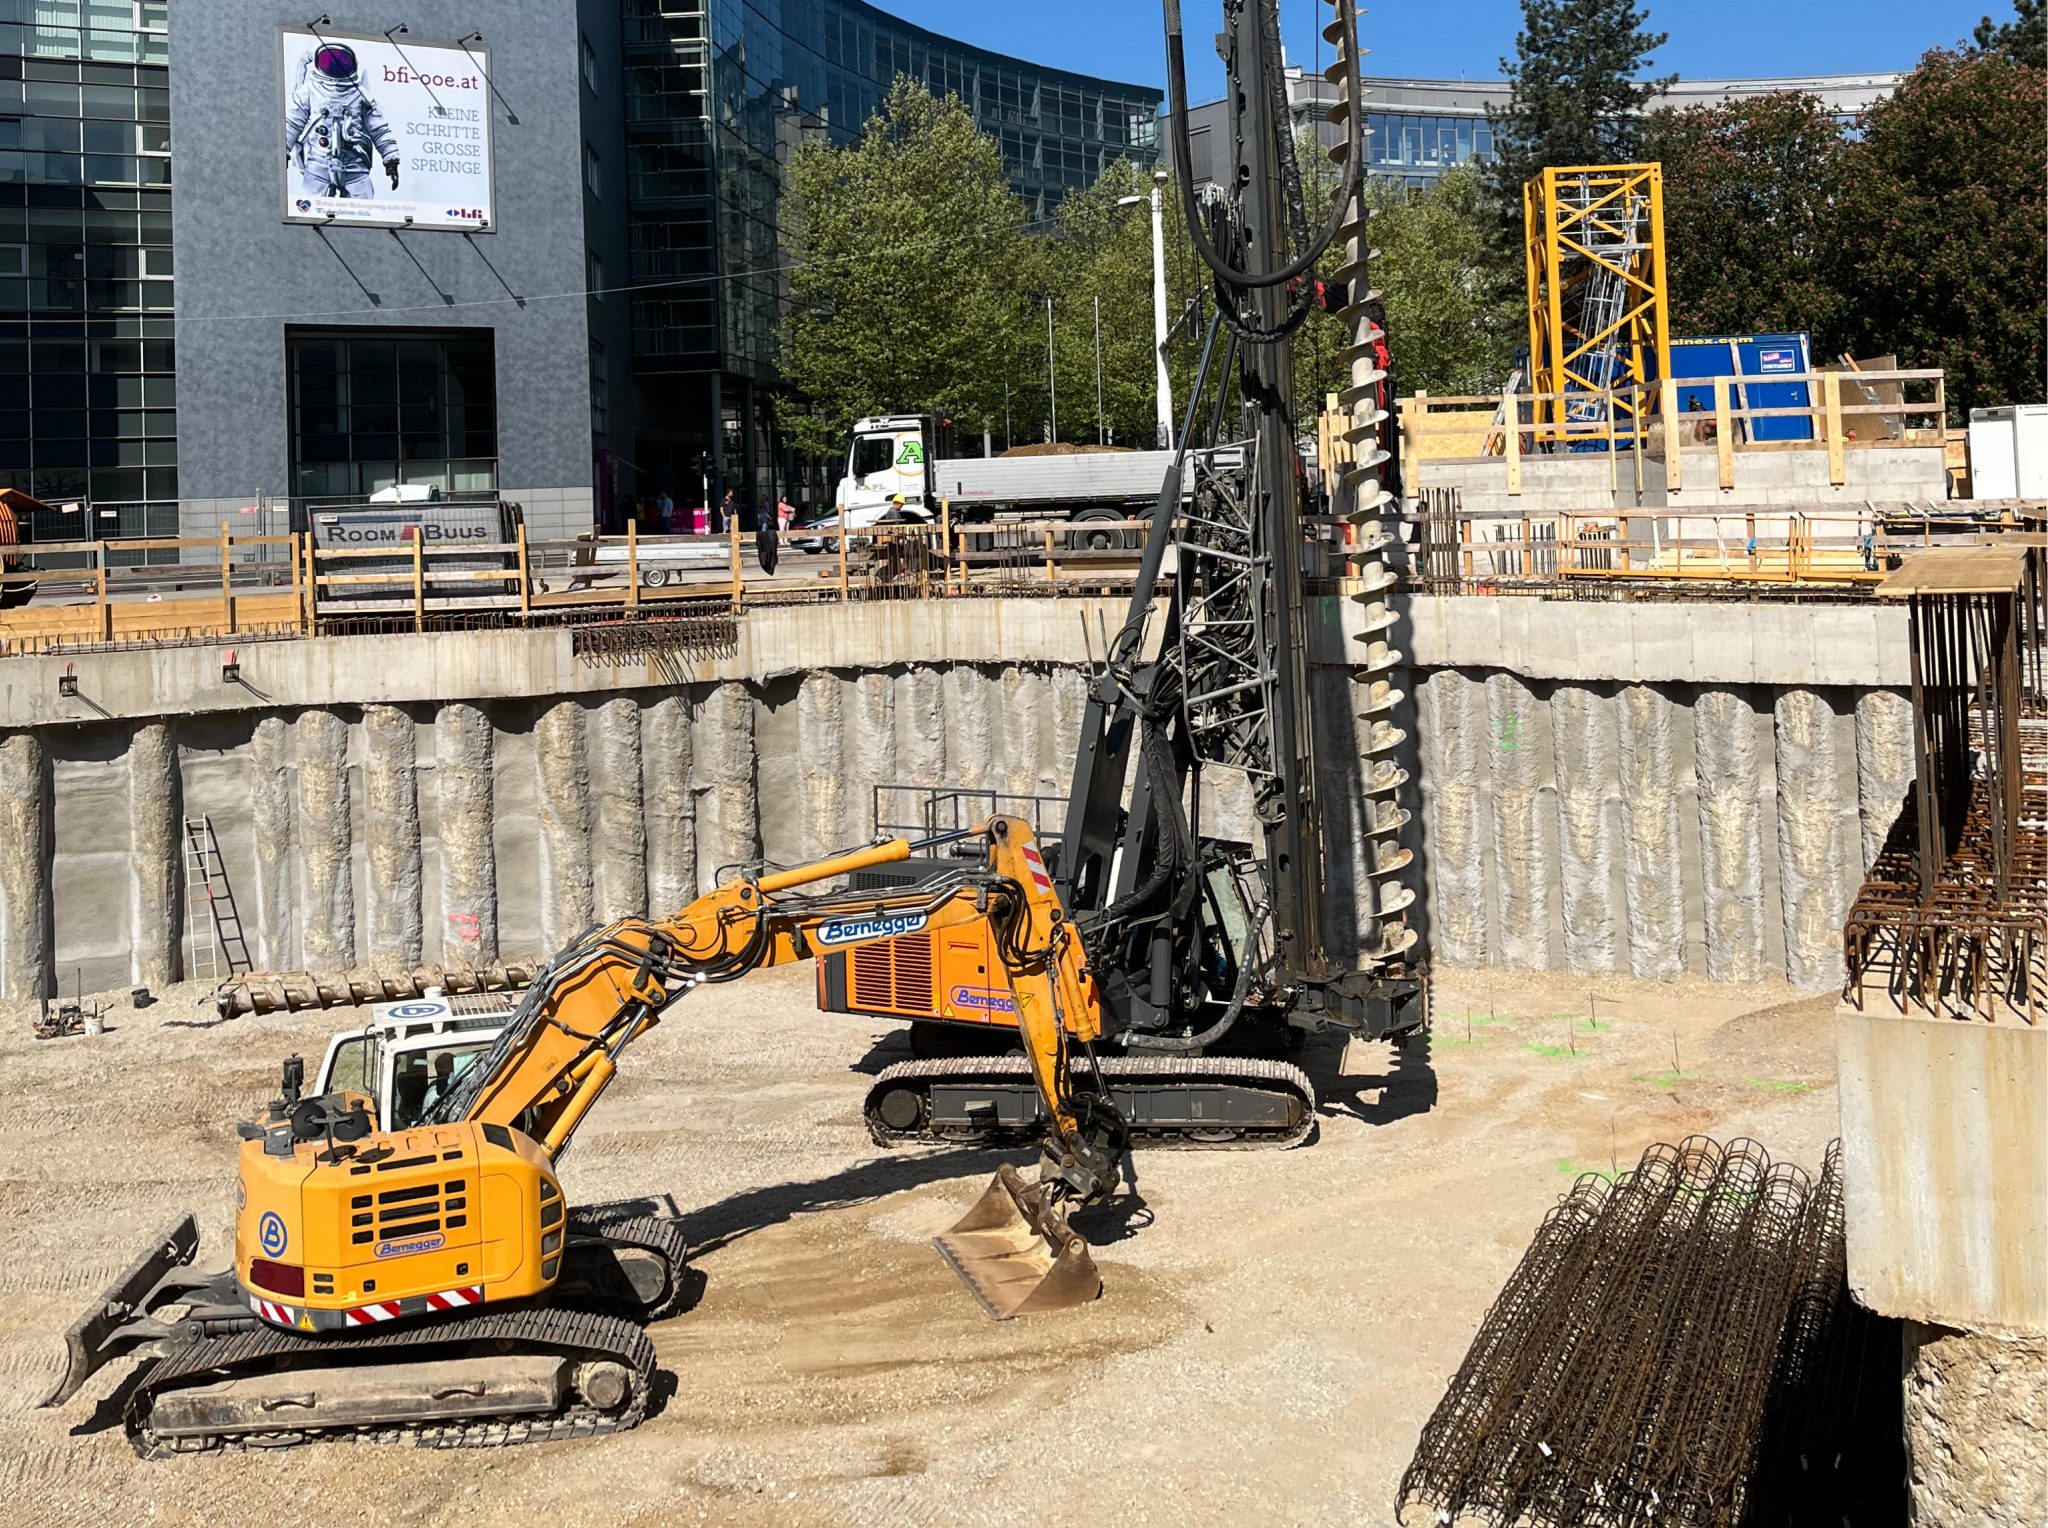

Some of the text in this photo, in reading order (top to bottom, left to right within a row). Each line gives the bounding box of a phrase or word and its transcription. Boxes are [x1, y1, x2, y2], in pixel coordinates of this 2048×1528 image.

[383, 65, 479, 90] bfi-ooe.at
[406, 122, 480, 140] SCHRITTE
[422, 141, 481, 157] GROSSE
[411, 158, 482, 175] SPRÜNGE
[1670, 337, 1754, 346] ainex.com
[896, 441, 924, 464] A
[825, 914, 922, 941] Bernegger
[956, 989, 1015, 1012] Bernegg
[263, 1219, 281, 1248] B
[381, 1239, 442, 1255] Bernegger
